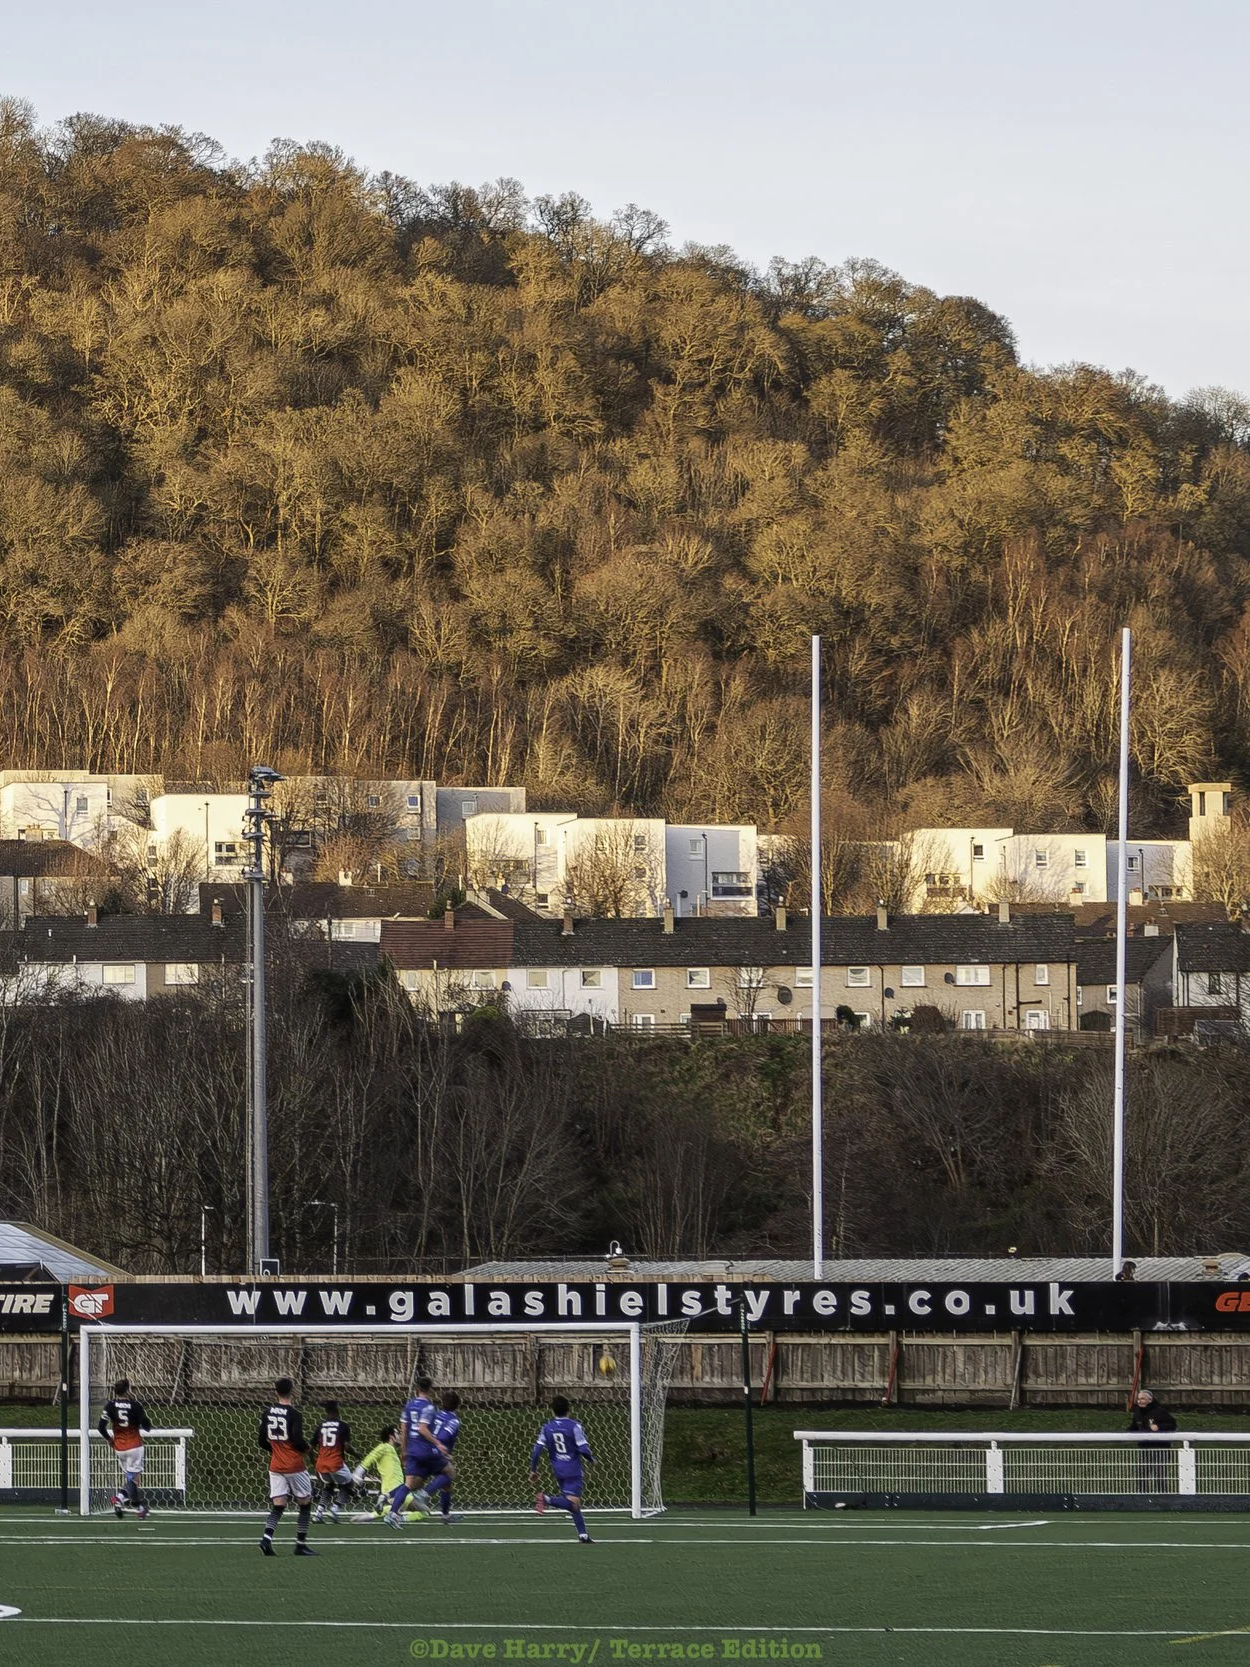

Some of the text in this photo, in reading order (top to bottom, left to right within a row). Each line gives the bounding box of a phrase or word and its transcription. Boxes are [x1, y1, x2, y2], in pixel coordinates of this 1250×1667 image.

[74, 1293, 109, 1313] GT
[227, 1283, 1074, 1321] www.galashielstyres.co.uk
[118, 1409, 129, 1427] 5
[267, 1415, 288, 1441] 23
[320, 1427, 338, 1447] 15
[553, 1433, 567, 1453] 8
